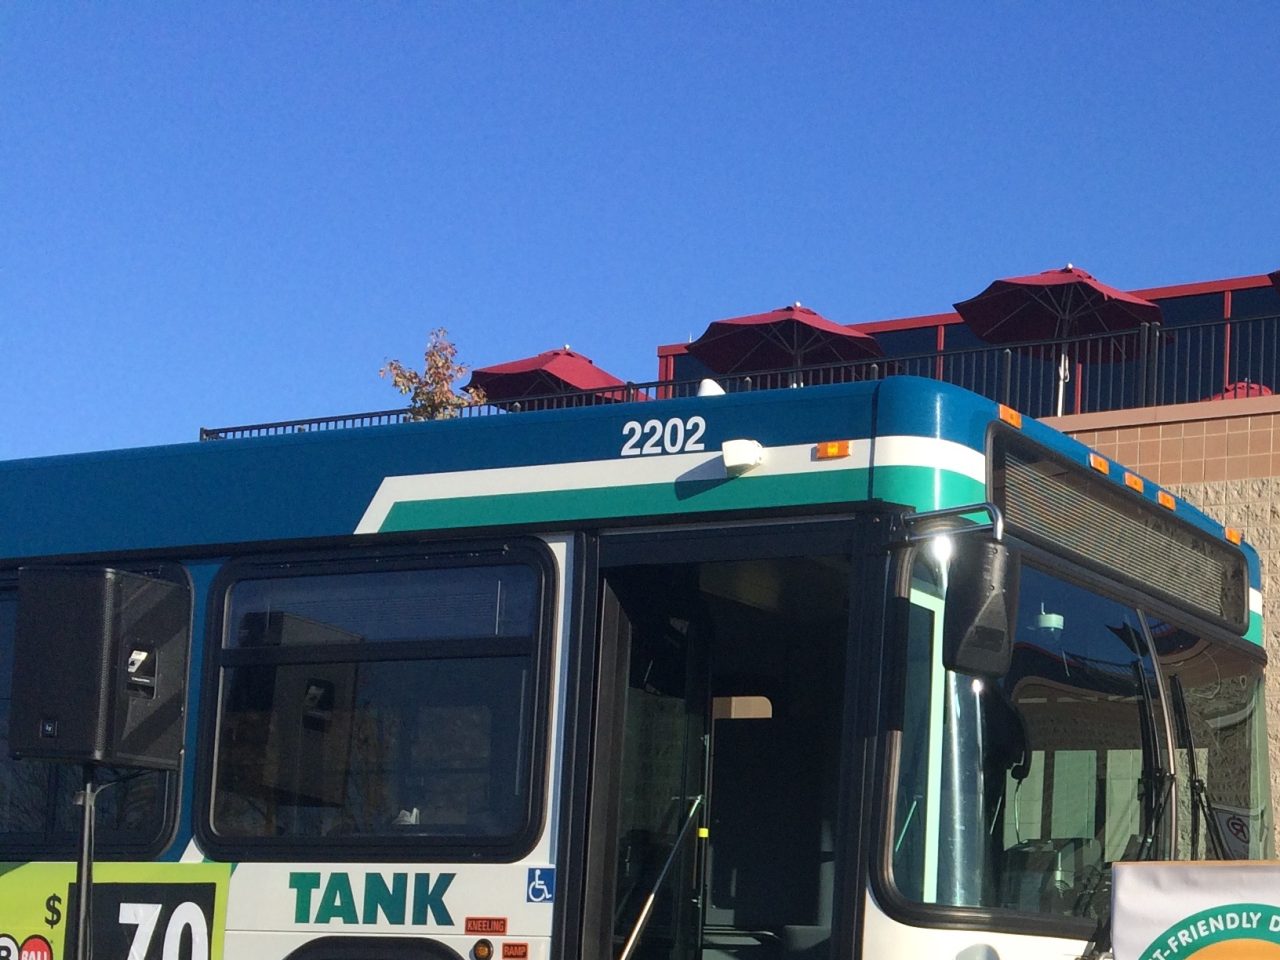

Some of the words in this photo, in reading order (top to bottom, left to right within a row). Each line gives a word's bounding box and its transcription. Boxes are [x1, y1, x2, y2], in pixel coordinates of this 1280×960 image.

[620, 416, 706, 456] 2202
[44, 893, 62, 929] $
[289, 871, 456, 926] TANK
[467, 918, 505, 932] KNEELING
[504, 945, 527, 958] RAMP
